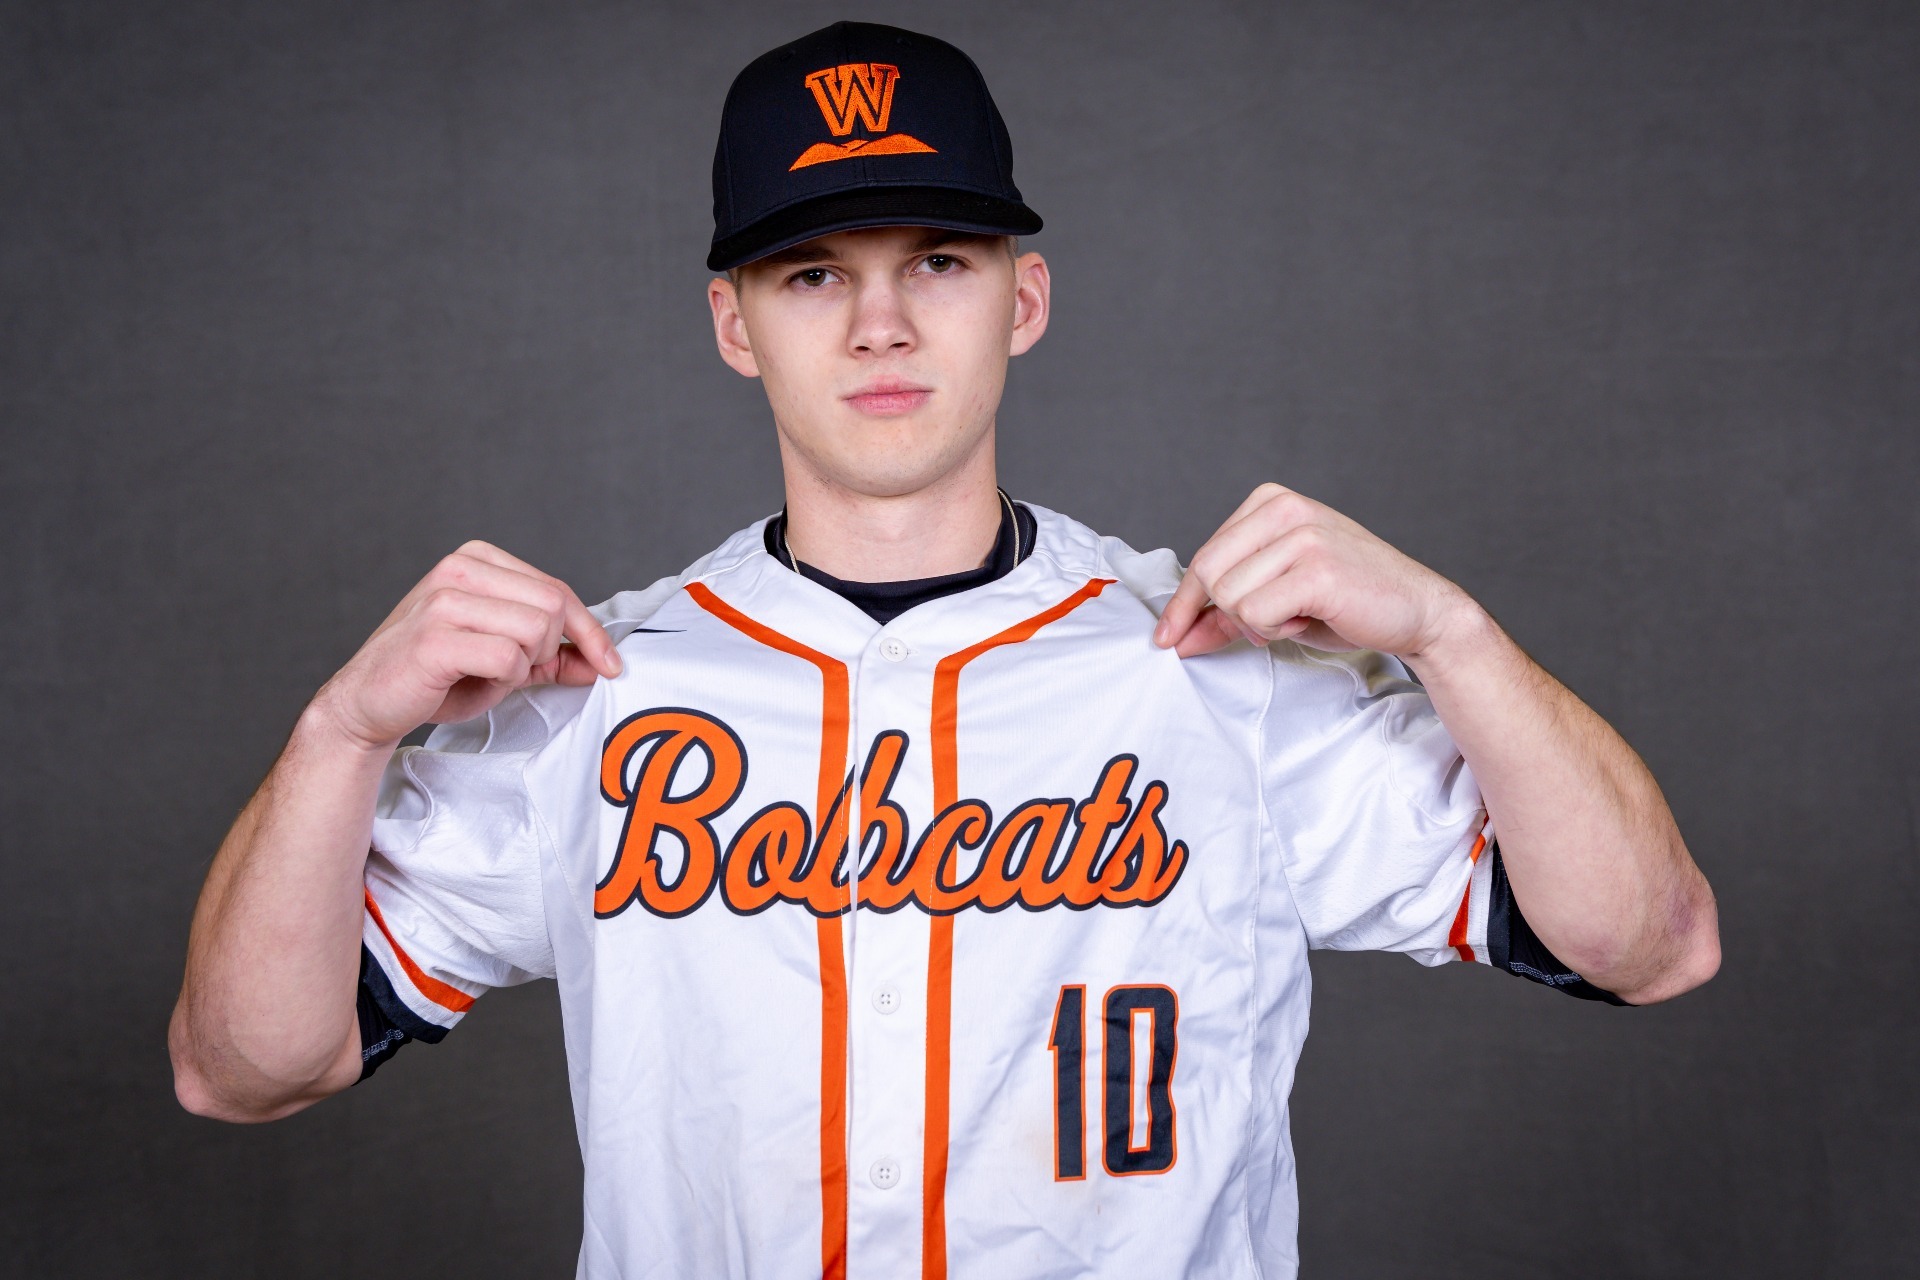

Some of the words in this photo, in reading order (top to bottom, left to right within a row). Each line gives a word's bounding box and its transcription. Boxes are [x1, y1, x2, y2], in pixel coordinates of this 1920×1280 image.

[804, 63, 900, 136] W
[594, 706, 1189, 919] Bobcats
[1047, 984, 1179, 1182] 10
